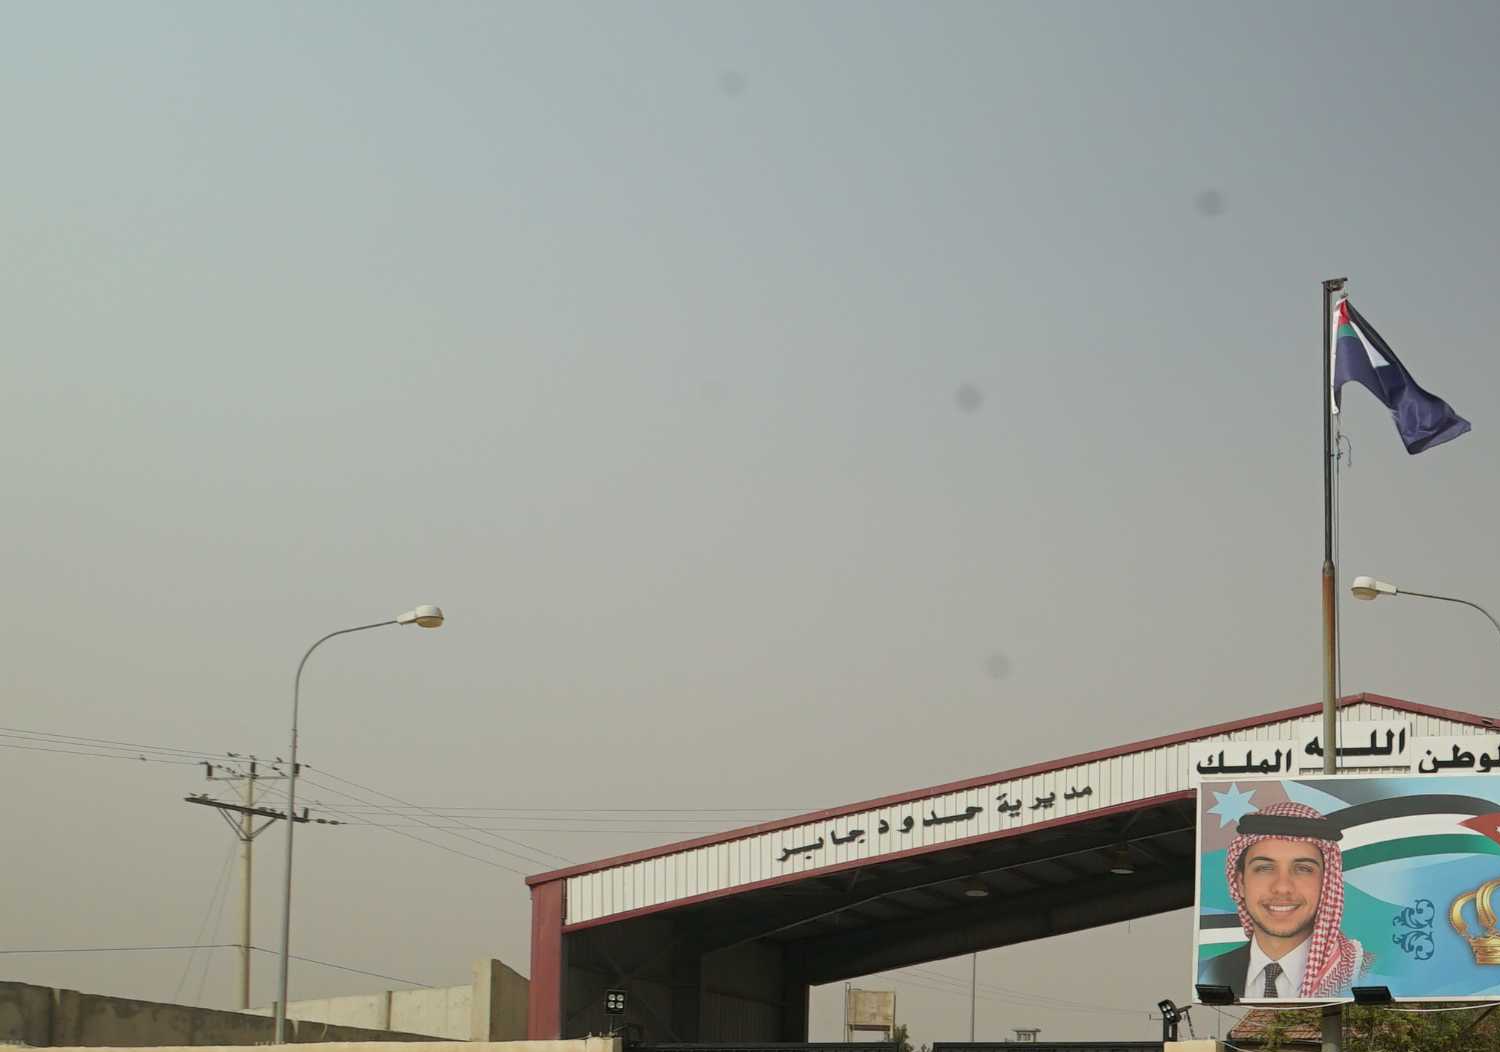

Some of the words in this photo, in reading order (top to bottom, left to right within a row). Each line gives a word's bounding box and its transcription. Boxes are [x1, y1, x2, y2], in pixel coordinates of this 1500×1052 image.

[1304, 727, 1406, 757] الله
[1196, 748, 1293, 775] الملك
[996, 785, 1093, 817] مديرية
[878, 804, 983, 834] حدود
[776, 829, 866, 861] جابر
